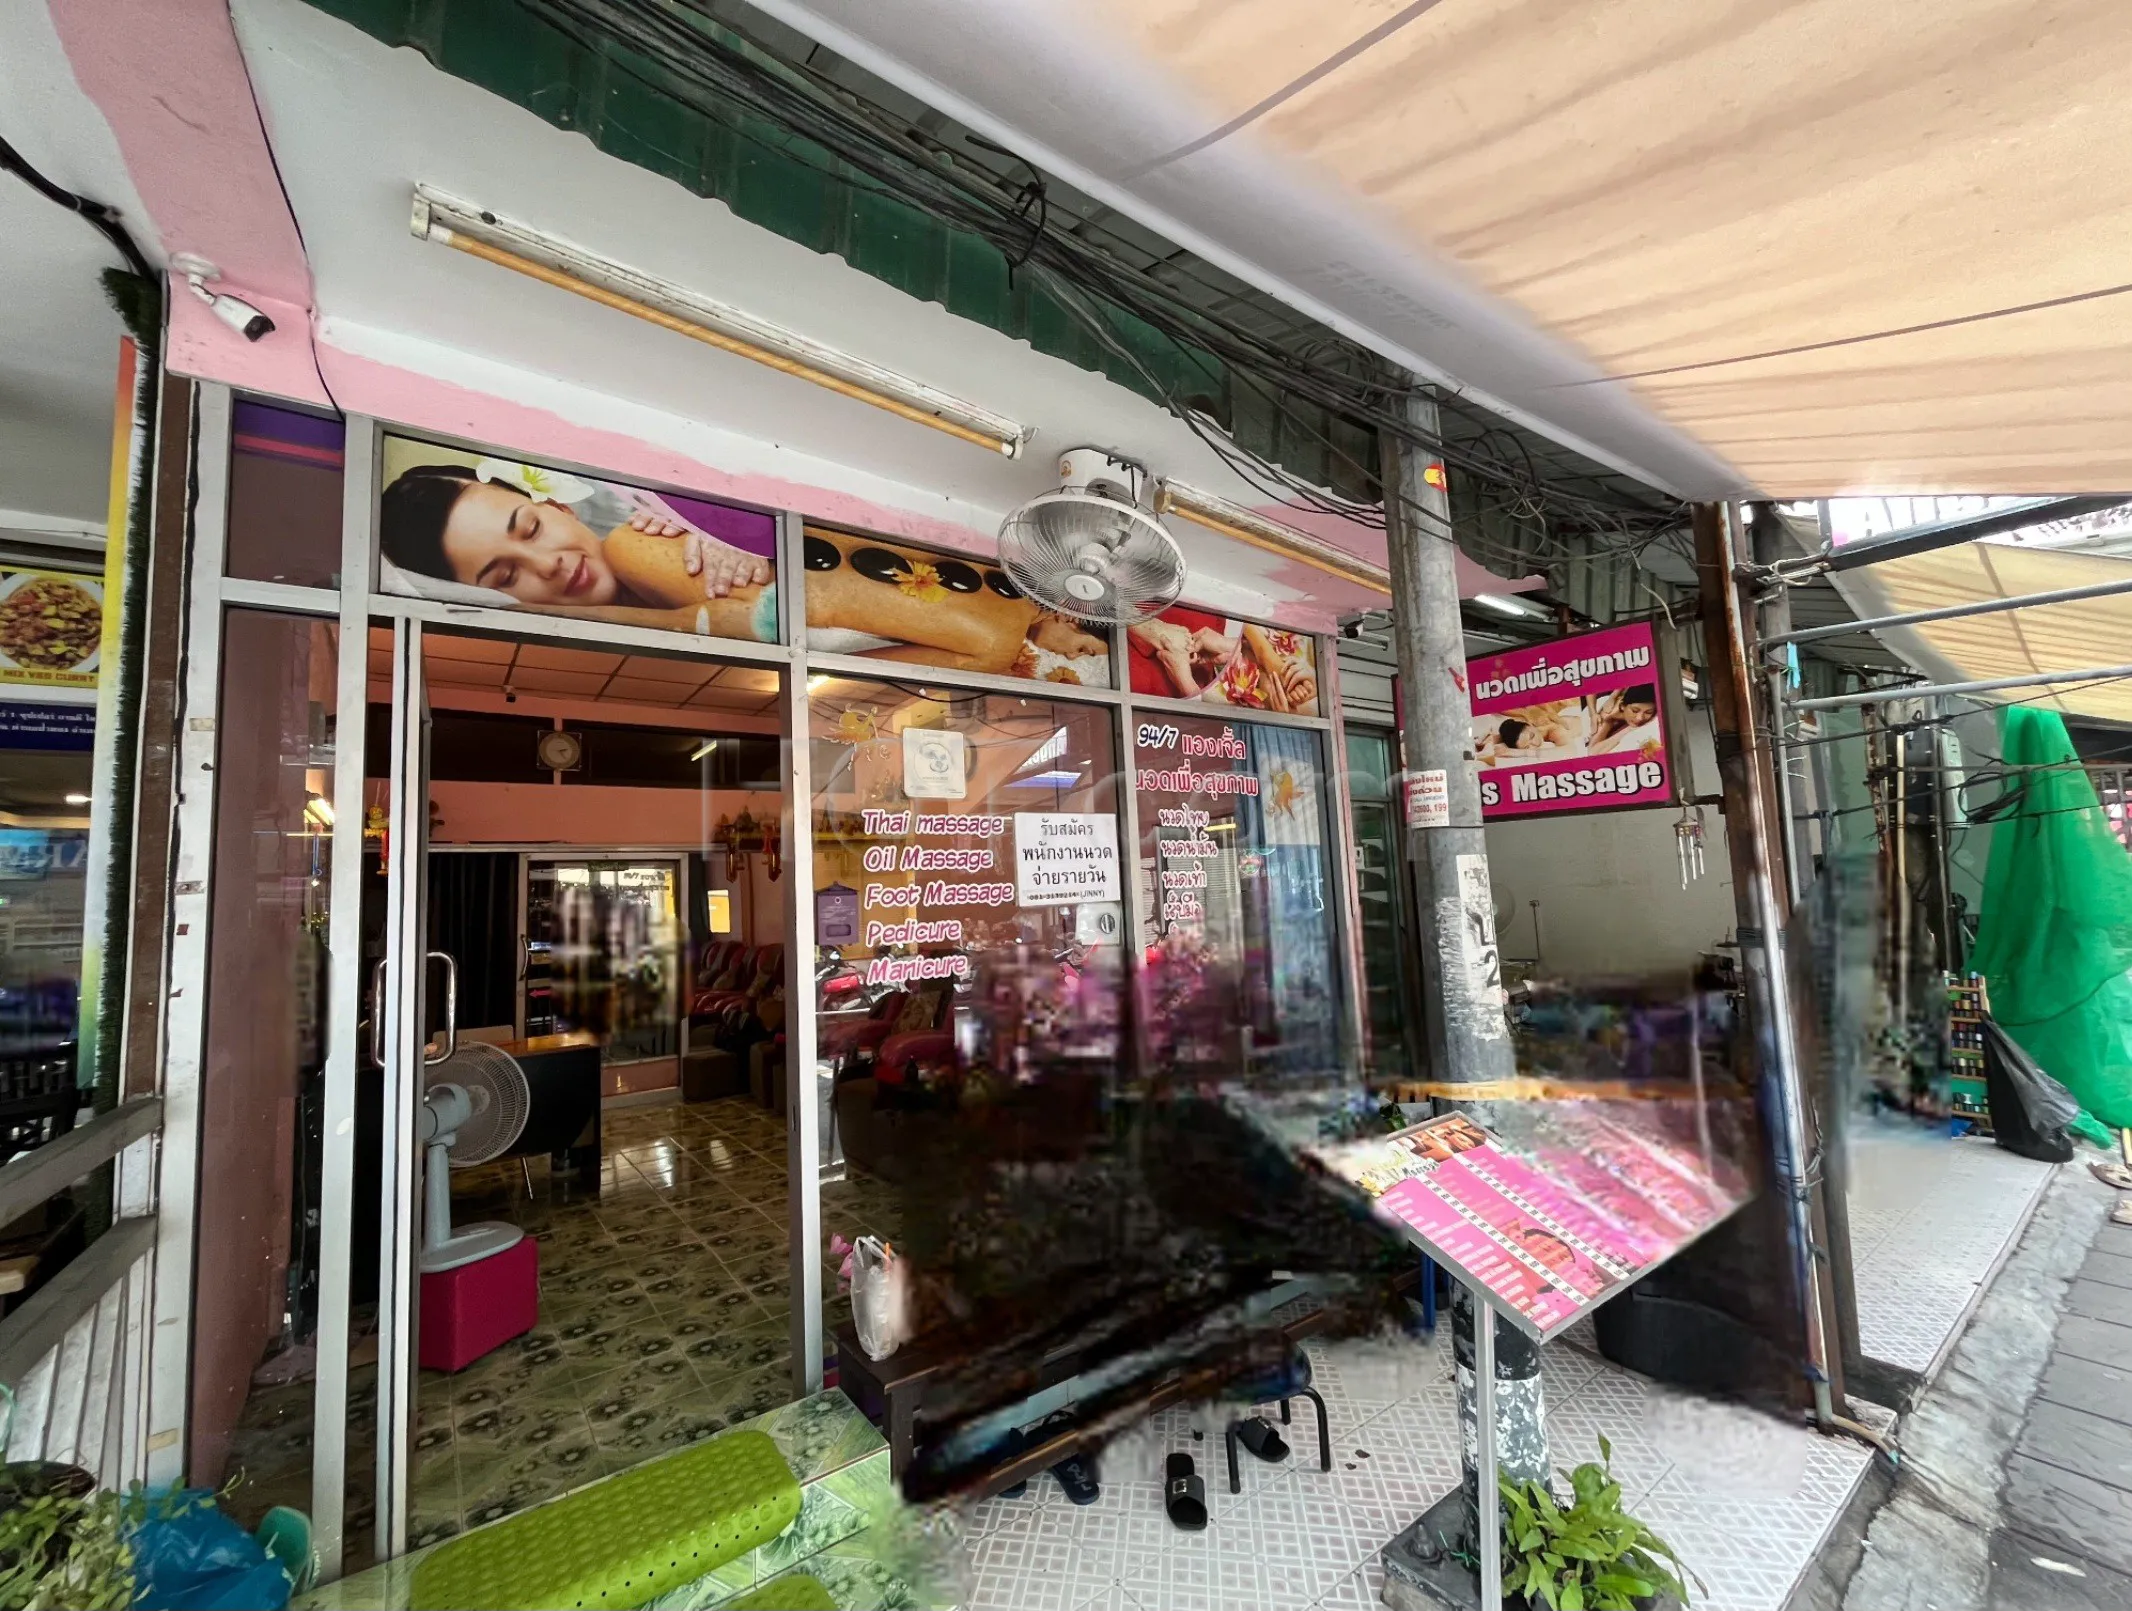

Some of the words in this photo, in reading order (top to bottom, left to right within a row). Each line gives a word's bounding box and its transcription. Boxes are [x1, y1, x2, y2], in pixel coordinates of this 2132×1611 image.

[1475, 646, 1650, 700] นวดเพื่อสุขภาพ
[1137, 723, 1179, 749] 94/7
[1511, 761, 1662, 803] Massage
[861, 808, 911, 835] Thai
[915, 814, 1004, 838] massage
[1040, 818, 1094, 836] รับสมัคร
[864, 846, 897, 872] Oil
[900, 845, 993, 872] Massage
[1022, 841, 1113, 861] พนักงานนวด
[1031, 864, 1106, 885] จ่ายรายวัน
[864, 883, 922, 909] Foot
[923, 880, 1015, 907] Massage
[866, 919, 962, 948] Pedicure
[867, 955, 968, 986] Manicure
